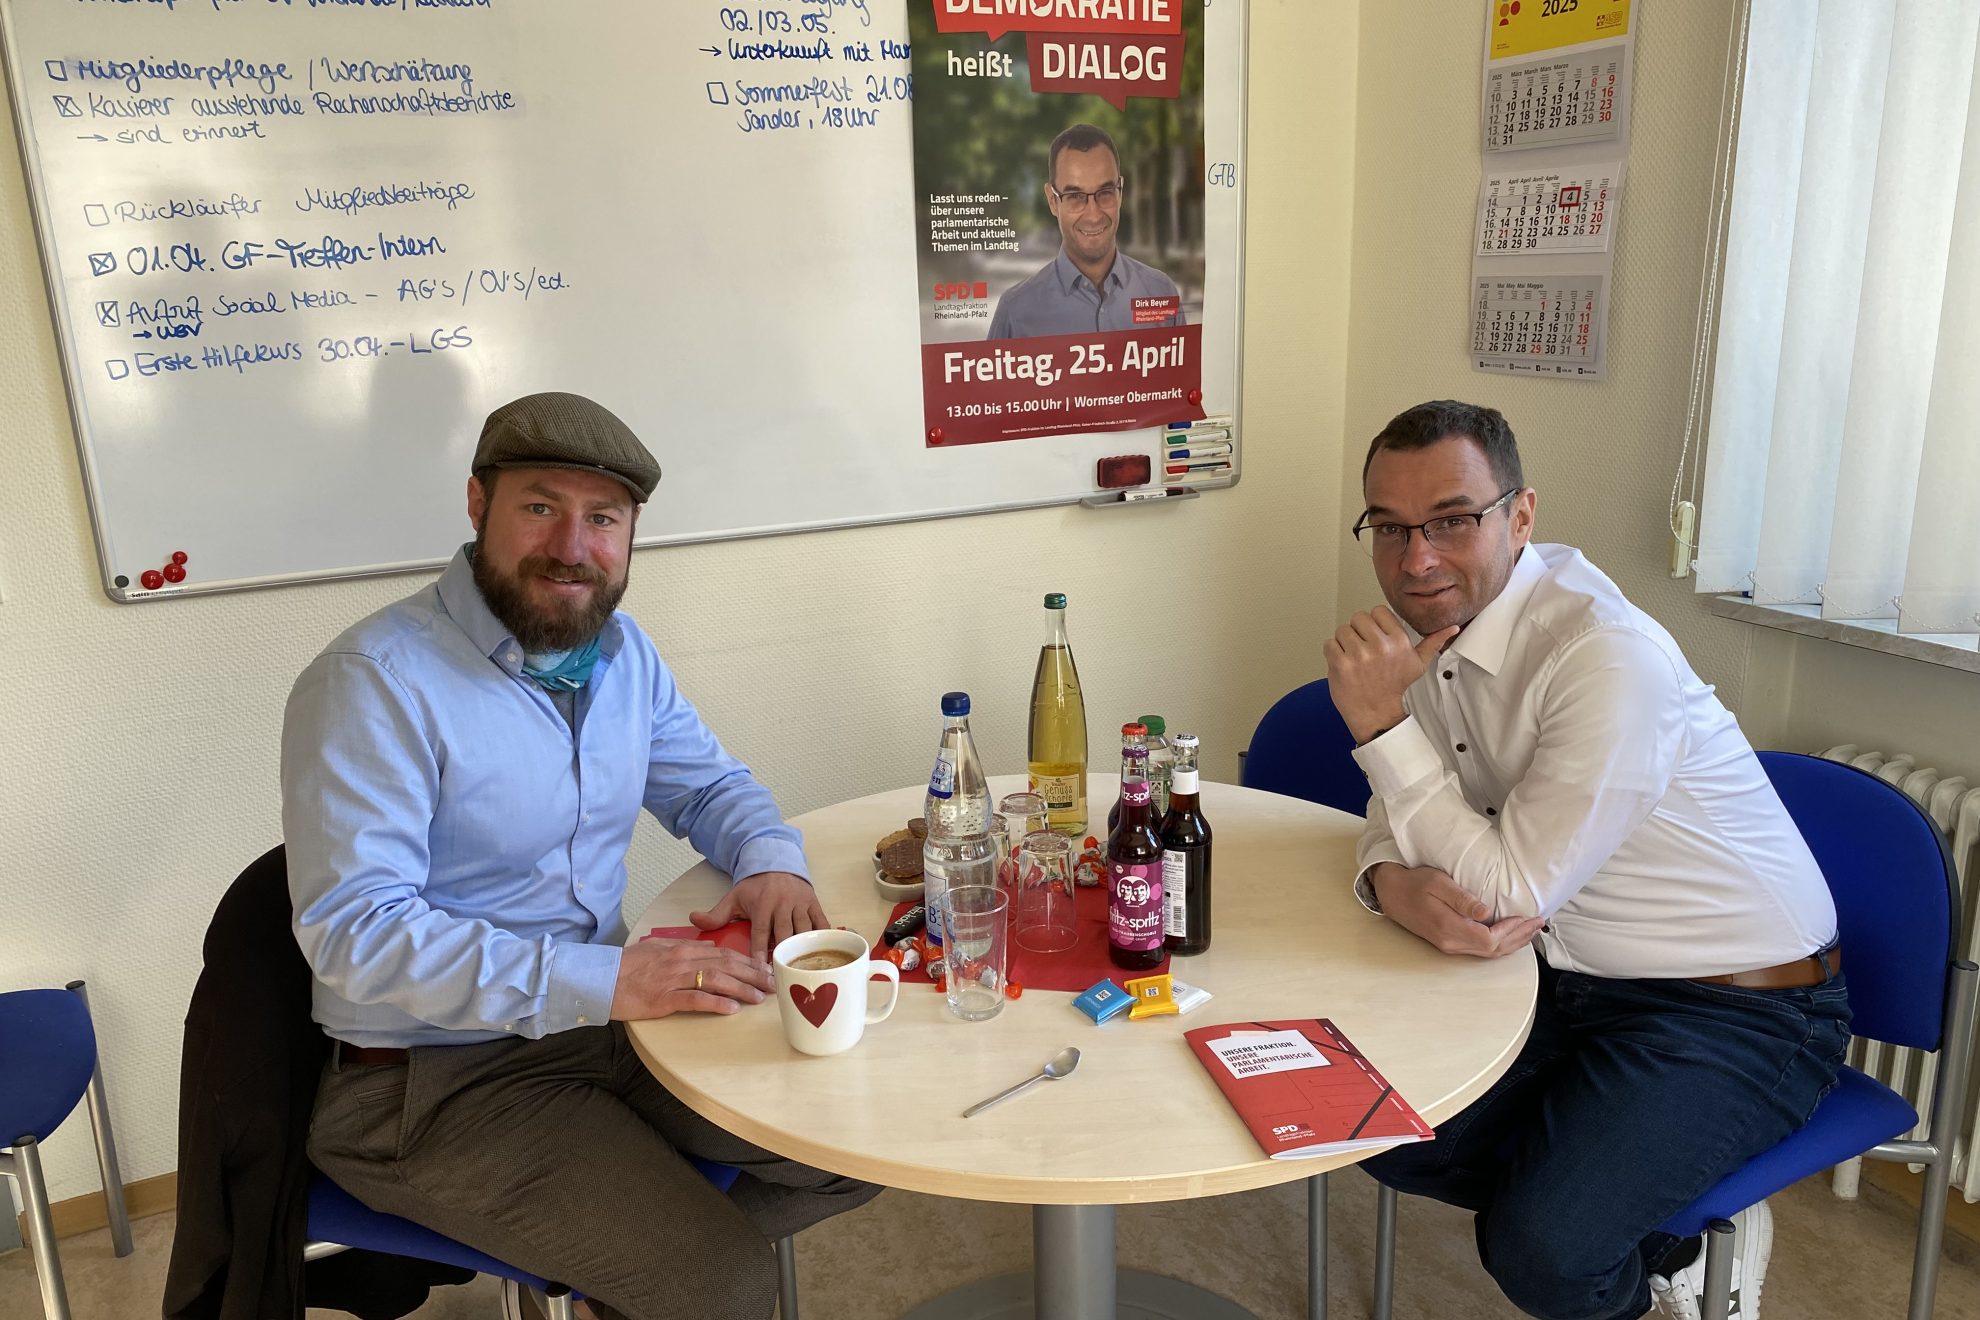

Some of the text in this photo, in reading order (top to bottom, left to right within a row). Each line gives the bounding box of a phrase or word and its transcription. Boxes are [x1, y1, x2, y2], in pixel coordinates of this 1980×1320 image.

[1541, 0, 1578, 17] 2025
[728, 37, 834, 63] Unterkunft
[843, 41, 874, 62] mit
[947, 43, 1167, 81] heißt DIALOG
[78, 56, 292, 94] Mitgliederpflege
[735, 75, 854, 109] Sommerfest
[1507, 87, 1613, 111] 10 11 12 13 14 15 16
[88, 87, 516, 118] Kassierer ausstehende Rechenschaftsberichte
[1506, 99, 1612, 122] 17 18 19 20 21 22 23
[116, 121, 267, 144] sind erinnert
[1208, 162, 1236, 188] GTB
[114, 181, 475, 222] Rückläufer Mitgliedsbeiträge
[930, 193, 955, 204] Lasst
[956, 194, 973, 203] uns
[974, 193, 1001, 203] reden
[1523, 190, 1606, 204] 1 2 3 4 5 6
[930, 205, 985, 216] über unsere
[1507, 208, 1511, 216] 7
[1521, 206, 1526, 215] 8
[1536, 206, 1540, 214] 9
[1546, 204, 1556, 214] 10
[1578, 203, 1587, 212] 12
[1594, 201, 1604, 211] 13
[931, 216, 1009, 231] parlamentarische
[1501, 213, 1602, 227] 14 15 16 17 18 19 20
[931, 228, 1016, 240] Arbeit und aktuelle
[1499, 224, 1601, 238] 21 22 23 24 25 26 27
[931, 240, 1020, 252] Themen im Landtag
[1497, 239, 1536, 249] 28 29 30
[934, 282, 971, 301] SPD
[126, 295, 204, 328] Aufruf
[212, 291, 286, 316] Social
[291, 290, 357, 310] Media
[933, 302, 988, 312] Landtagsfraktion
[1135, 299, 1170, 308] Dirk Beyer
[934, 311, 988, 320] Rheinland-Pfalz
[1492, 322, 1589, 333] 12 13 14 15 16 17 18
[134, 352, 198, 376] Erste
[202, 342, 302, 374] Hilfekurs
[944, 336, 1185, 387] Freitag, 25. April
[946, 404, 982, 418] 13.00
[984, 401, 1002, 415] bis
[1005, 400, 1039, 414] 15.00
[1041, 397, 1062, 411] Uhr
[1074, 393, 1125, 409] Wormser
[1127, 387, 1183, 403] Obermarkt
[1044, 784, 1073, 795] Genuss
[1110, 906, 1160, 931] fritz-spritz
[1221, 1041, 1297, 1057] UNSERE FRAKTION.
[1226, 1052, 1259, 1063] UNSERE
[1231, 1051, 1314, 1068] PARLAMENTARISCHE
[1238, 1064, 1271, 1075] ARBEIT.
[1272, 1125, 1299, 1135] SPD
